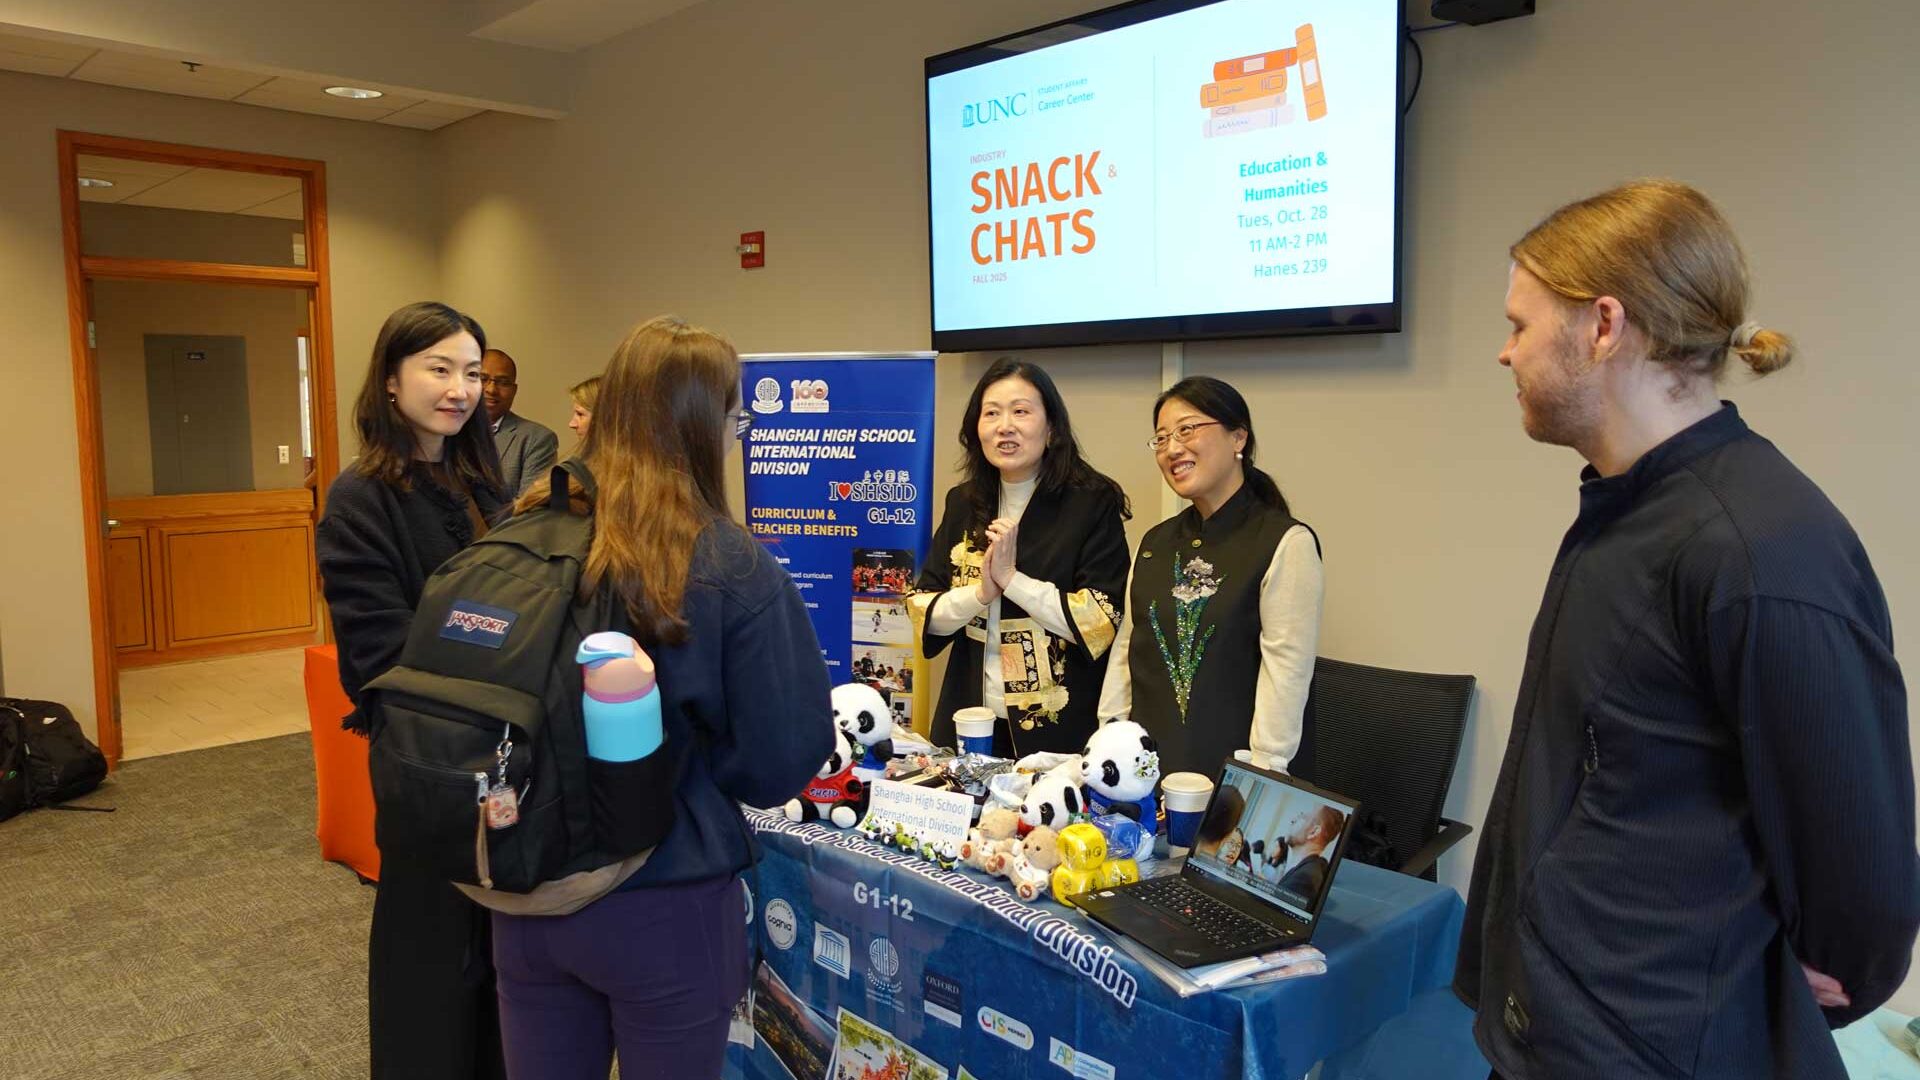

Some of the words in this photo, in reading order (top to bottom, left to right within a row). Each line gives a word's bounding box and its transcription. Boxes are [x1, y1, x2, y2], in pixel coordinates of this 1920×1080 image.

[976, 92, 1027, 124] UNC
[1038, 99, 1065, 111] Career
[1067, 92, 1095, 105] Center
[970, 150, 1006, 164] INDUSTRY
[1240, 154, 1311, 177] Education
[1316, 151, 1328, 166] &
[971, 150, 1102, 214] SNACK
[1108, 164, 1117, 178] &
[1245, 178, 1328, 202] Humanities
[1237, 214, 1273, 228] Tues,
[1277, 209, 1305, 224] Oct.
[1311, 205, 1327, 220] 28
[971, 209, 1096, 265] CHATS
[1249, 239, 1261, 253] 11
[1266, 234, 1301, 250] AM-2
[1306, 232, 1327, 246] PM
[1254, 264, 1298, 277] Hanes
[1303, 258, 1327, 274] 239
[973, 274, 988, 285] FALL
[990, 272, 1007, 283] 2025
[750, 429, 819, 442] SHANGHAI
[822, 429, 856, 442] HIGH
[859, 429, 916, 443] SCHOOL
[750, 445, 856, 459] INTERNATIONAL
[750, 462, 810, 475] DIVISION
[851, 482, 917, 503] SHSID
[752, 508, 825, 520] CURRICULUM
[827, 508, 836, 520] &
[867, 507, 916, 525] G1-12
[752, 522, 802, 535] TEACHER
[804, 524, 858, 537] BENEFITS
[802, 572, 833, 580] curriculum
[446, 610, 509, 635] JANSPORT
[874, 786, 913, 805] Shanghai
[916, 793, 935, 810] High
[937, 799, 967, 816] School
[872, 805, 926, 828] International
[928, 817, 964, 837] Division
[854, 881, 914, 922] G1-12
[1034, 918, 1137, 1008] Division
[926, 975, 960, 995] OXFORD
[981, 1010, 1009, 1036] CIS
[1055, 1045, 1073, 1066] AP
